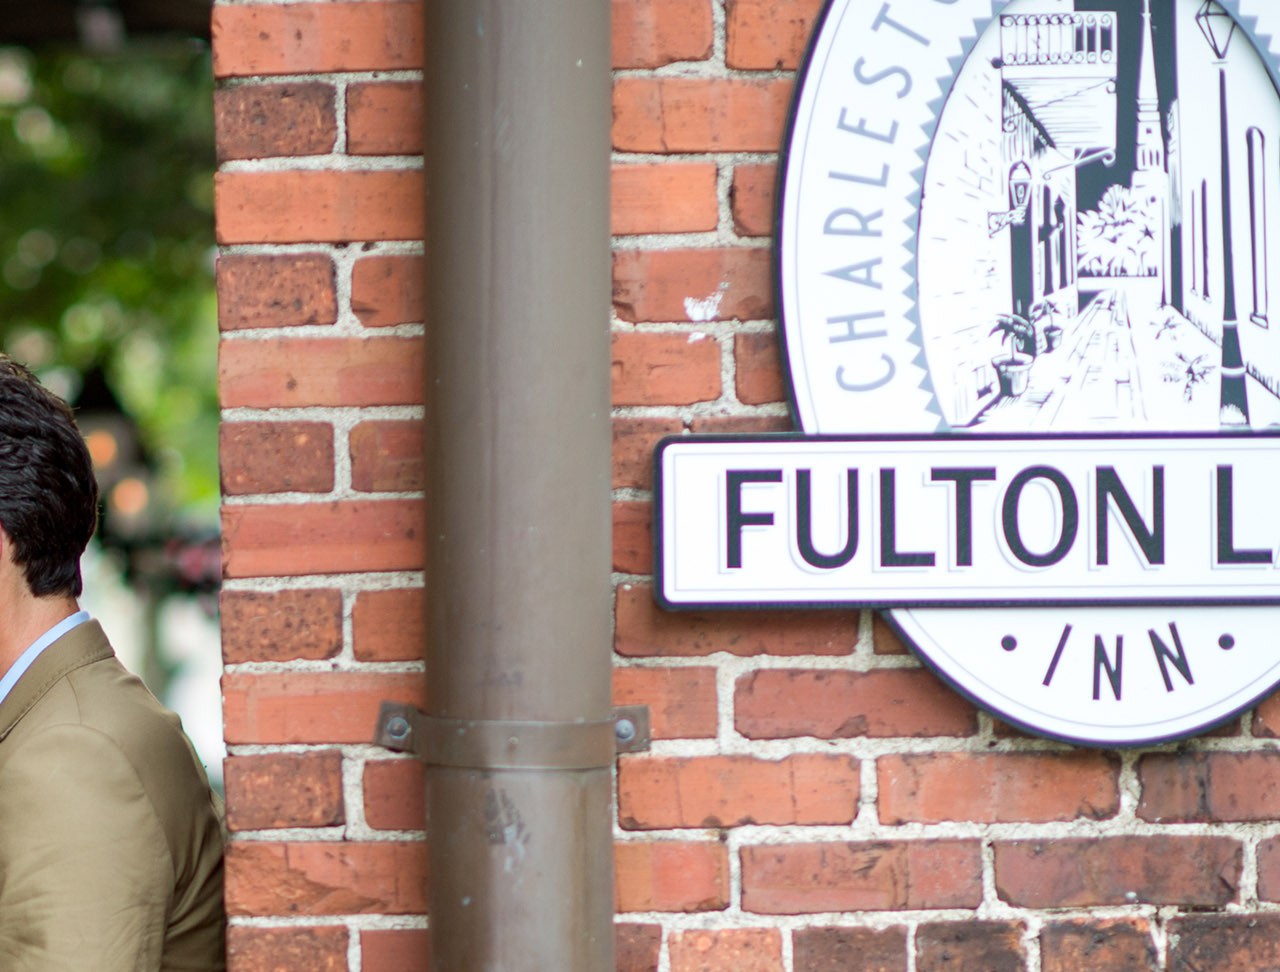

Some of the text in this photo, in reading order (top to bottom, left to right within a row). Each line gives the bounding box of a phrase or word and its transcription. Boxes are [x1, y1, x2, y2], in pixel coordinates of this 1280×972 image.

[823, 0, 961, 393] CHARLEST
[725, 464, 1280, 569] FULTON L
[1042, 622, 1195, 701] INN
